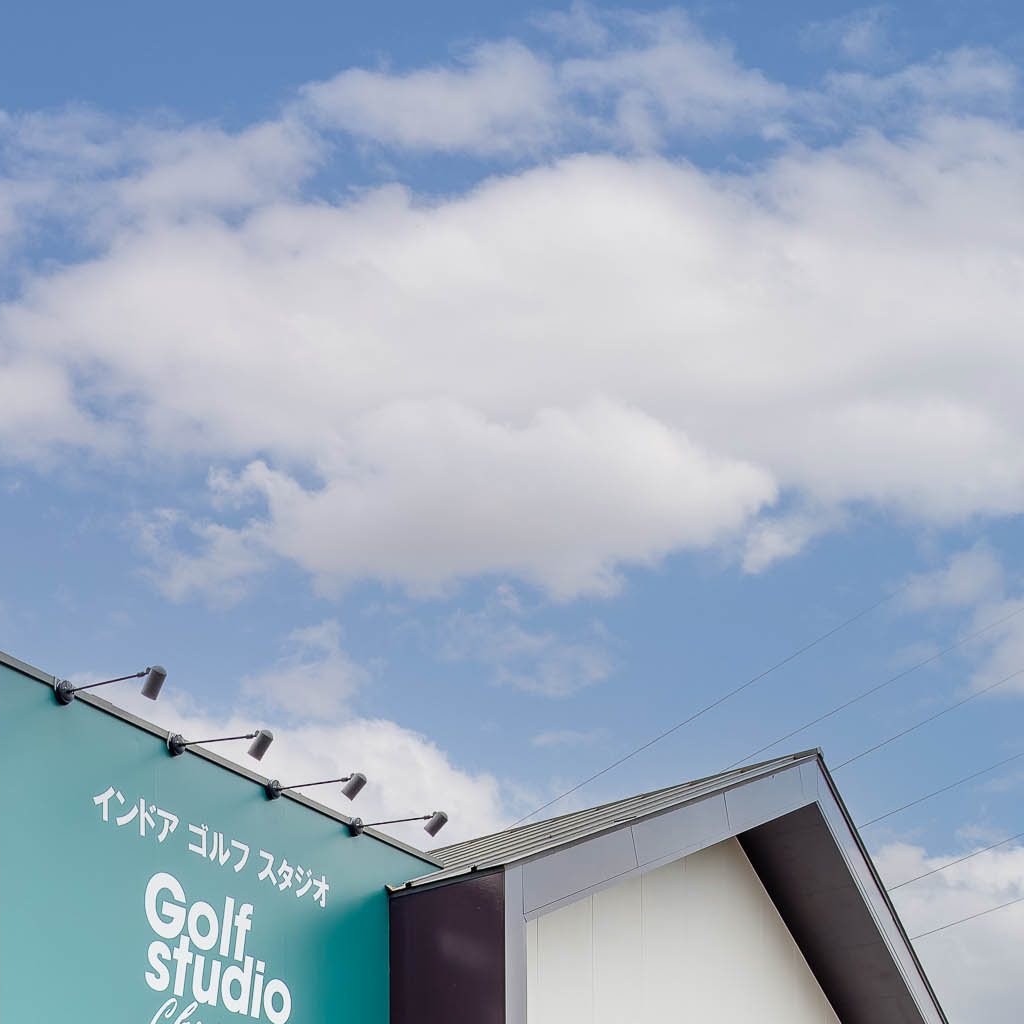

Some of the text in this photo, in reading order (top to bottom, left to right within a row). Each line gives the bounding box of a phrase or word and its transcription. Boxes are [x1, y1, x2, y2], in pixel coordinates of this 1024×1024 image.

[93, 786, 330, 908] インドア ゴルフ スタジオ
[145, 872, 254, 962] Golf
